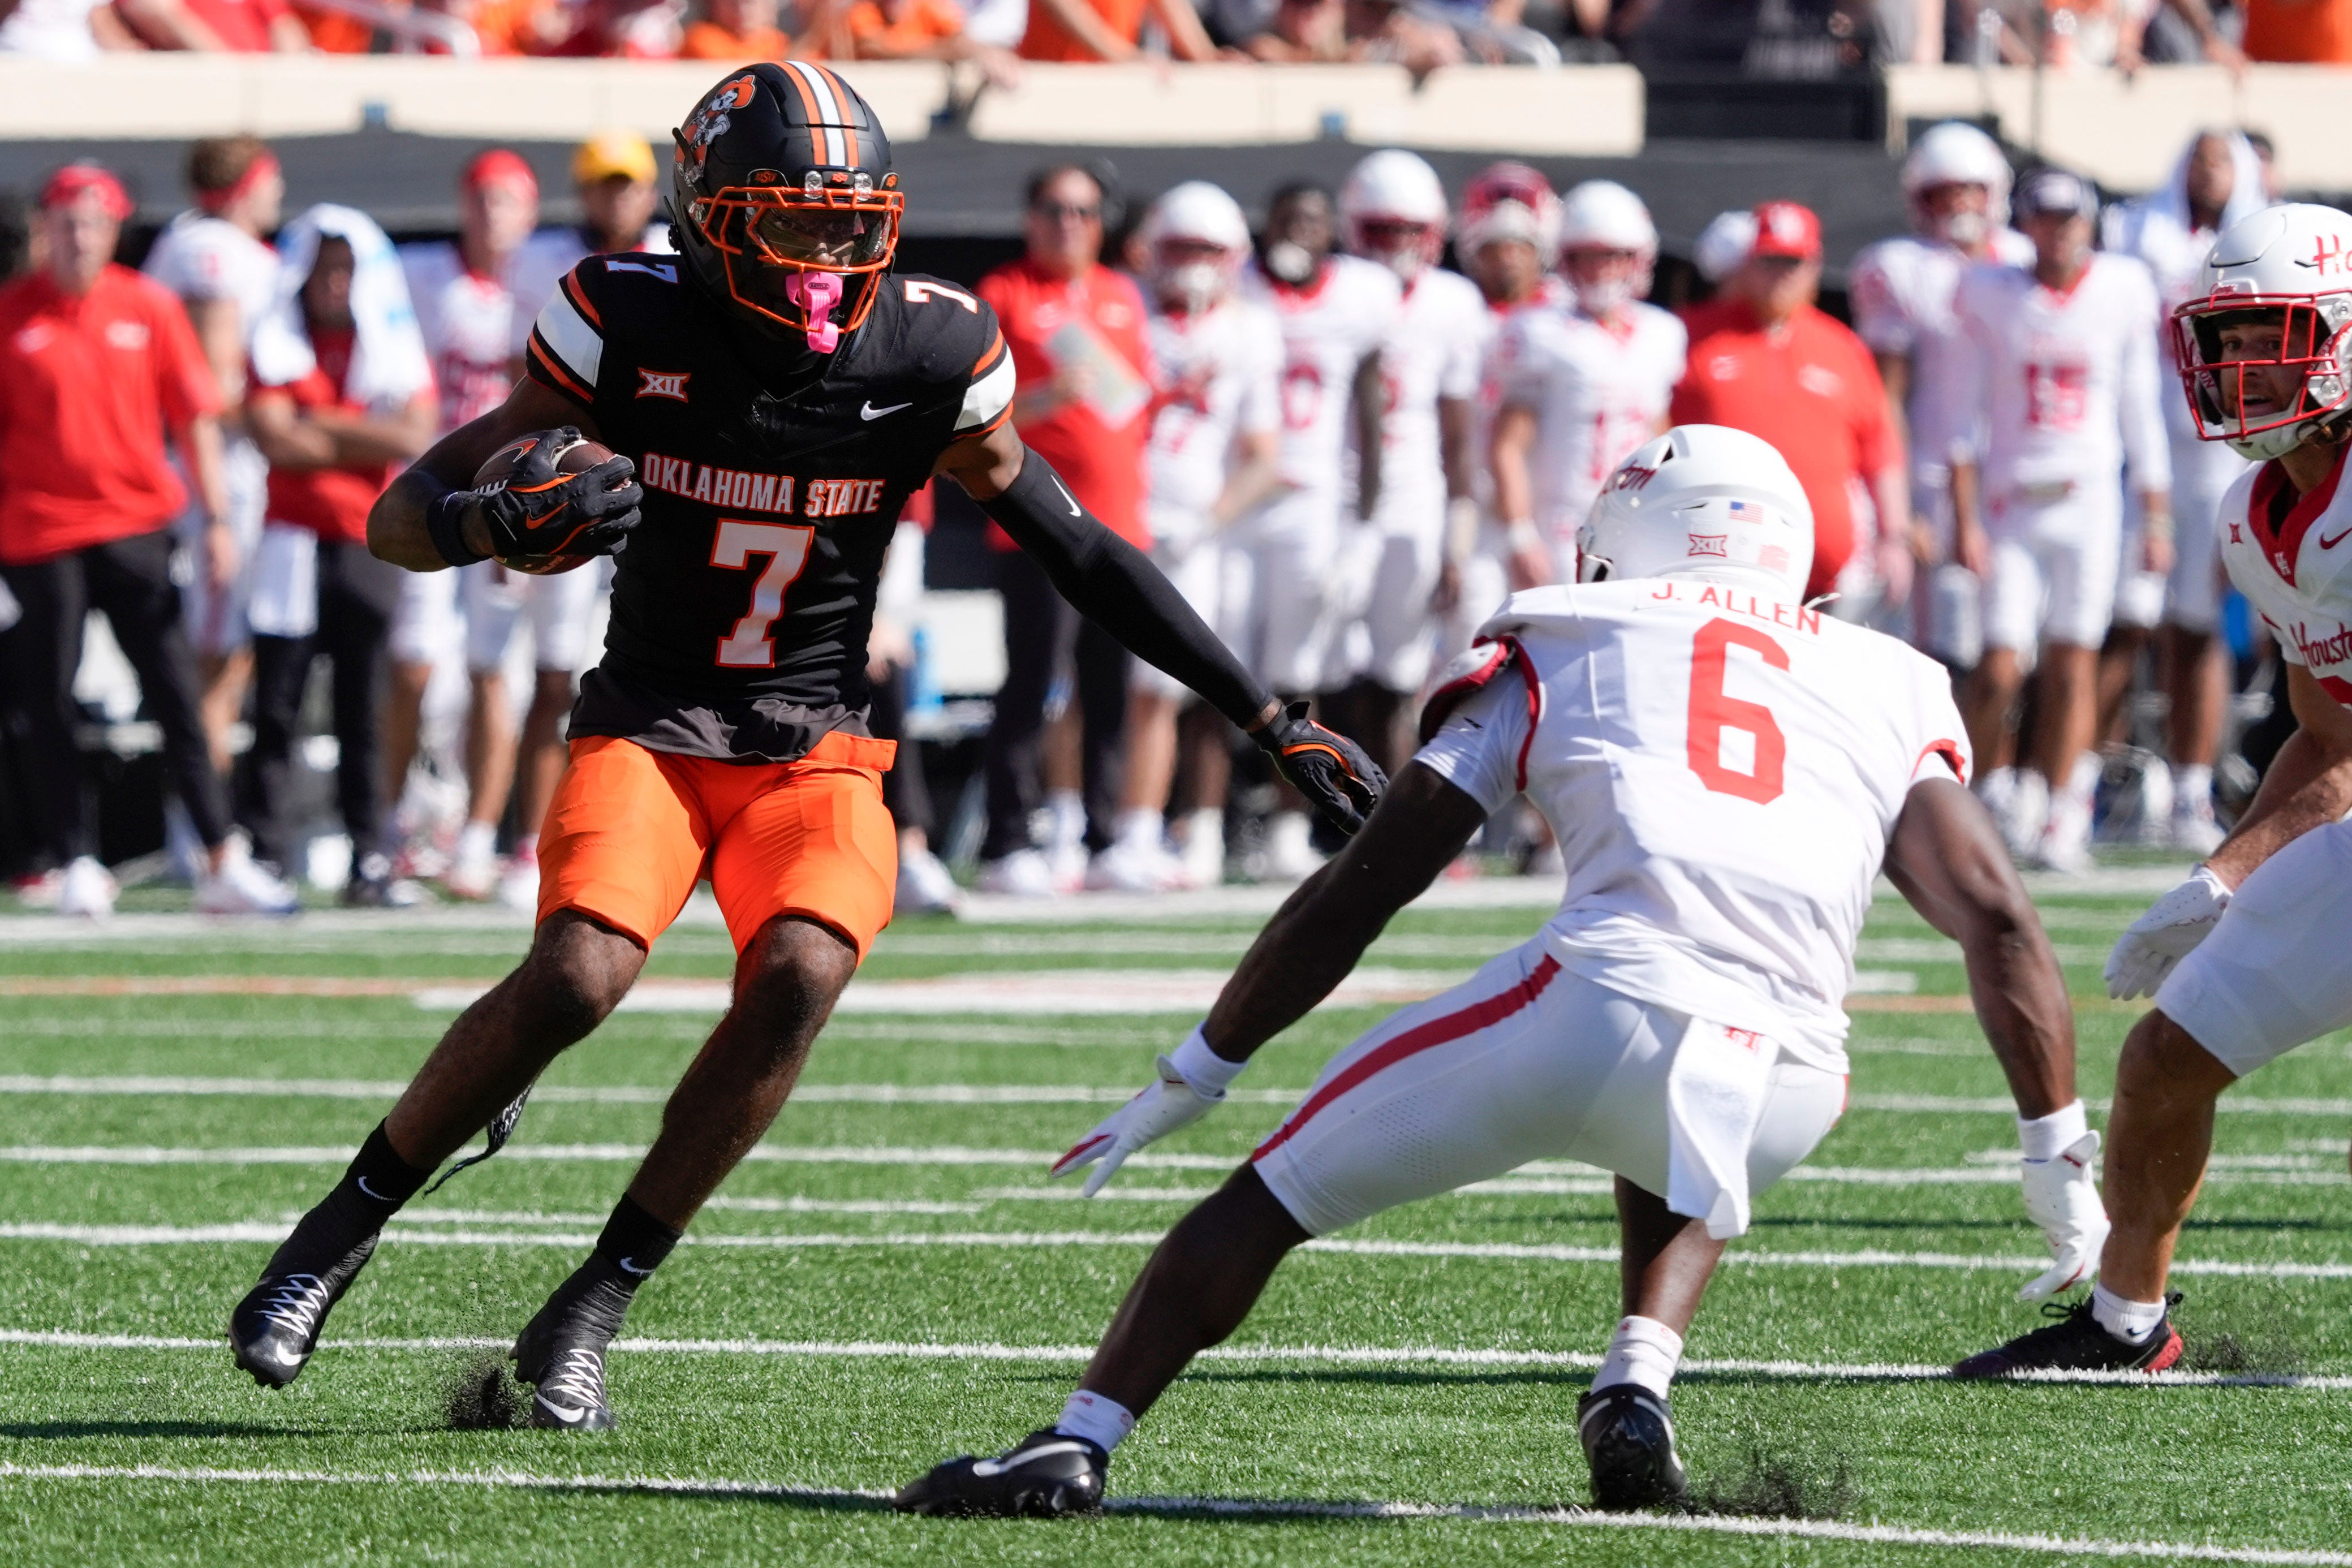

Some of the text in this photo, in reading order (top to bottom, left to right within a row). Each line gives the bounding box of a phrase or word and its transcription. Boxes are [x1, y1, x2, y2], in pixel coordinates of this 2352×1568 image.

[604, 260, 679, 283] 7
[904, 279, 978, 314] 7
[643, 453, 886, 518] OKLAHOMA STATE
[709, 517, 815, 669] 7
[1652, 583, 1821, 636] J. ALLEN
[1687, 617, 1791, 806] 6
